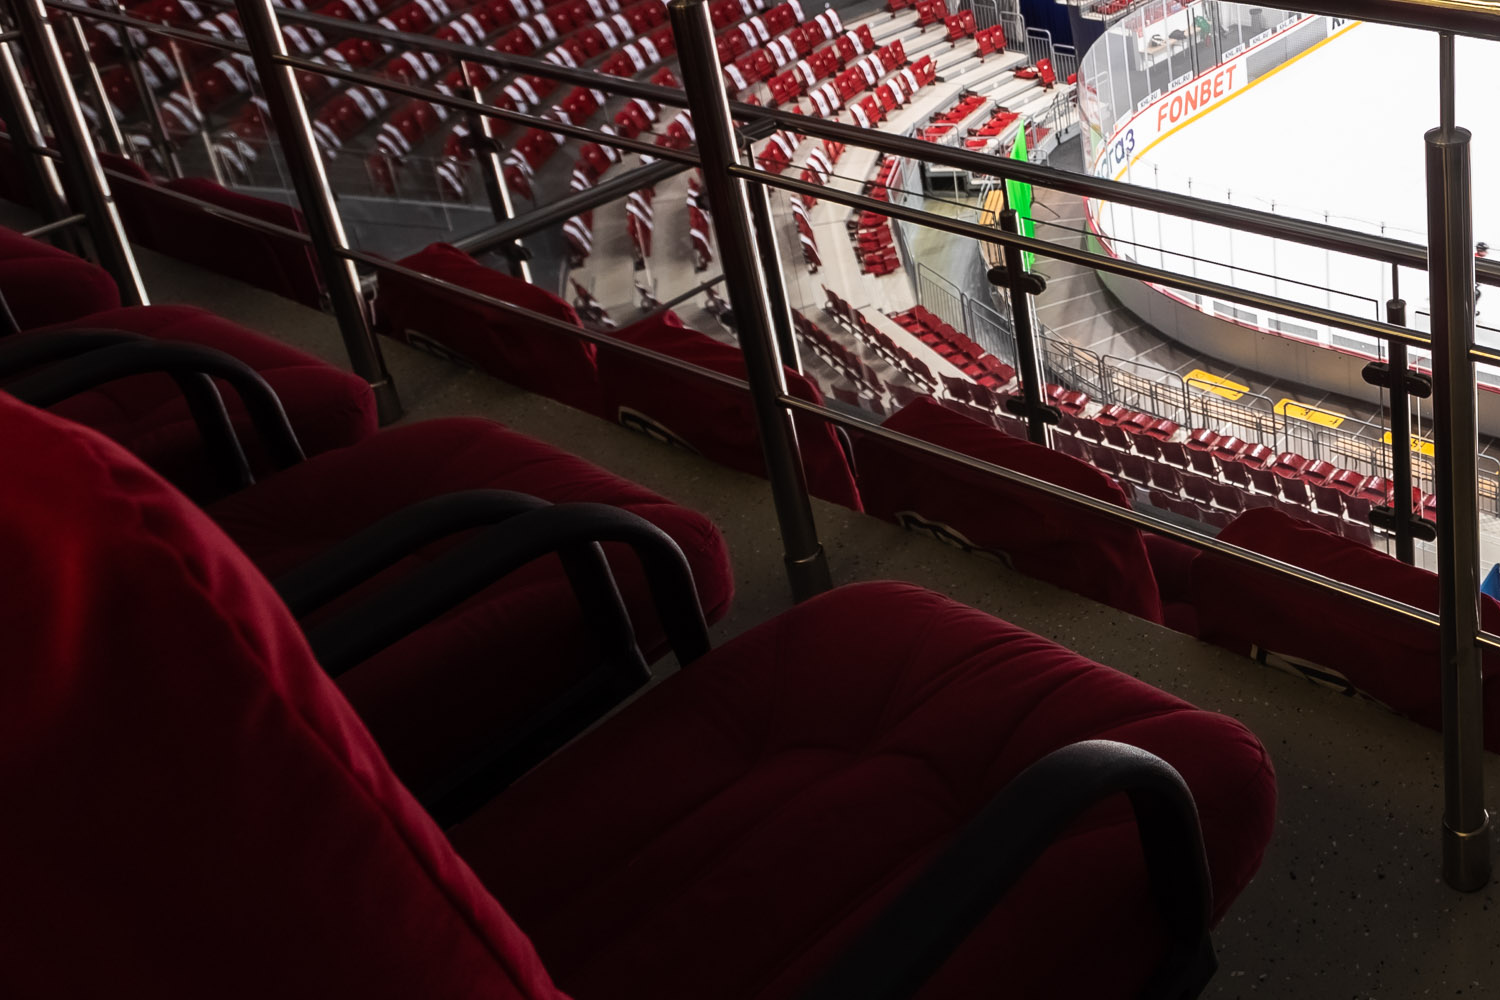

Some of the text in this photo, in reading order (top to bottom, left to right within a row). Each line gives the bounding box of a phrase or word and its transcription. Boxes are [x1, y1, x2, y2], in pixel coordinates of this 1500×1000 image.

[1225, 45, 1244, 60] KHL.RU
[1171, 72, 1191, 88] KHL.RU
[1140, 92, 1158, 108] KHL.RU
[1157, 64, 1237, 132] FONBET
[1095, 128, 1135, 178] огаз
